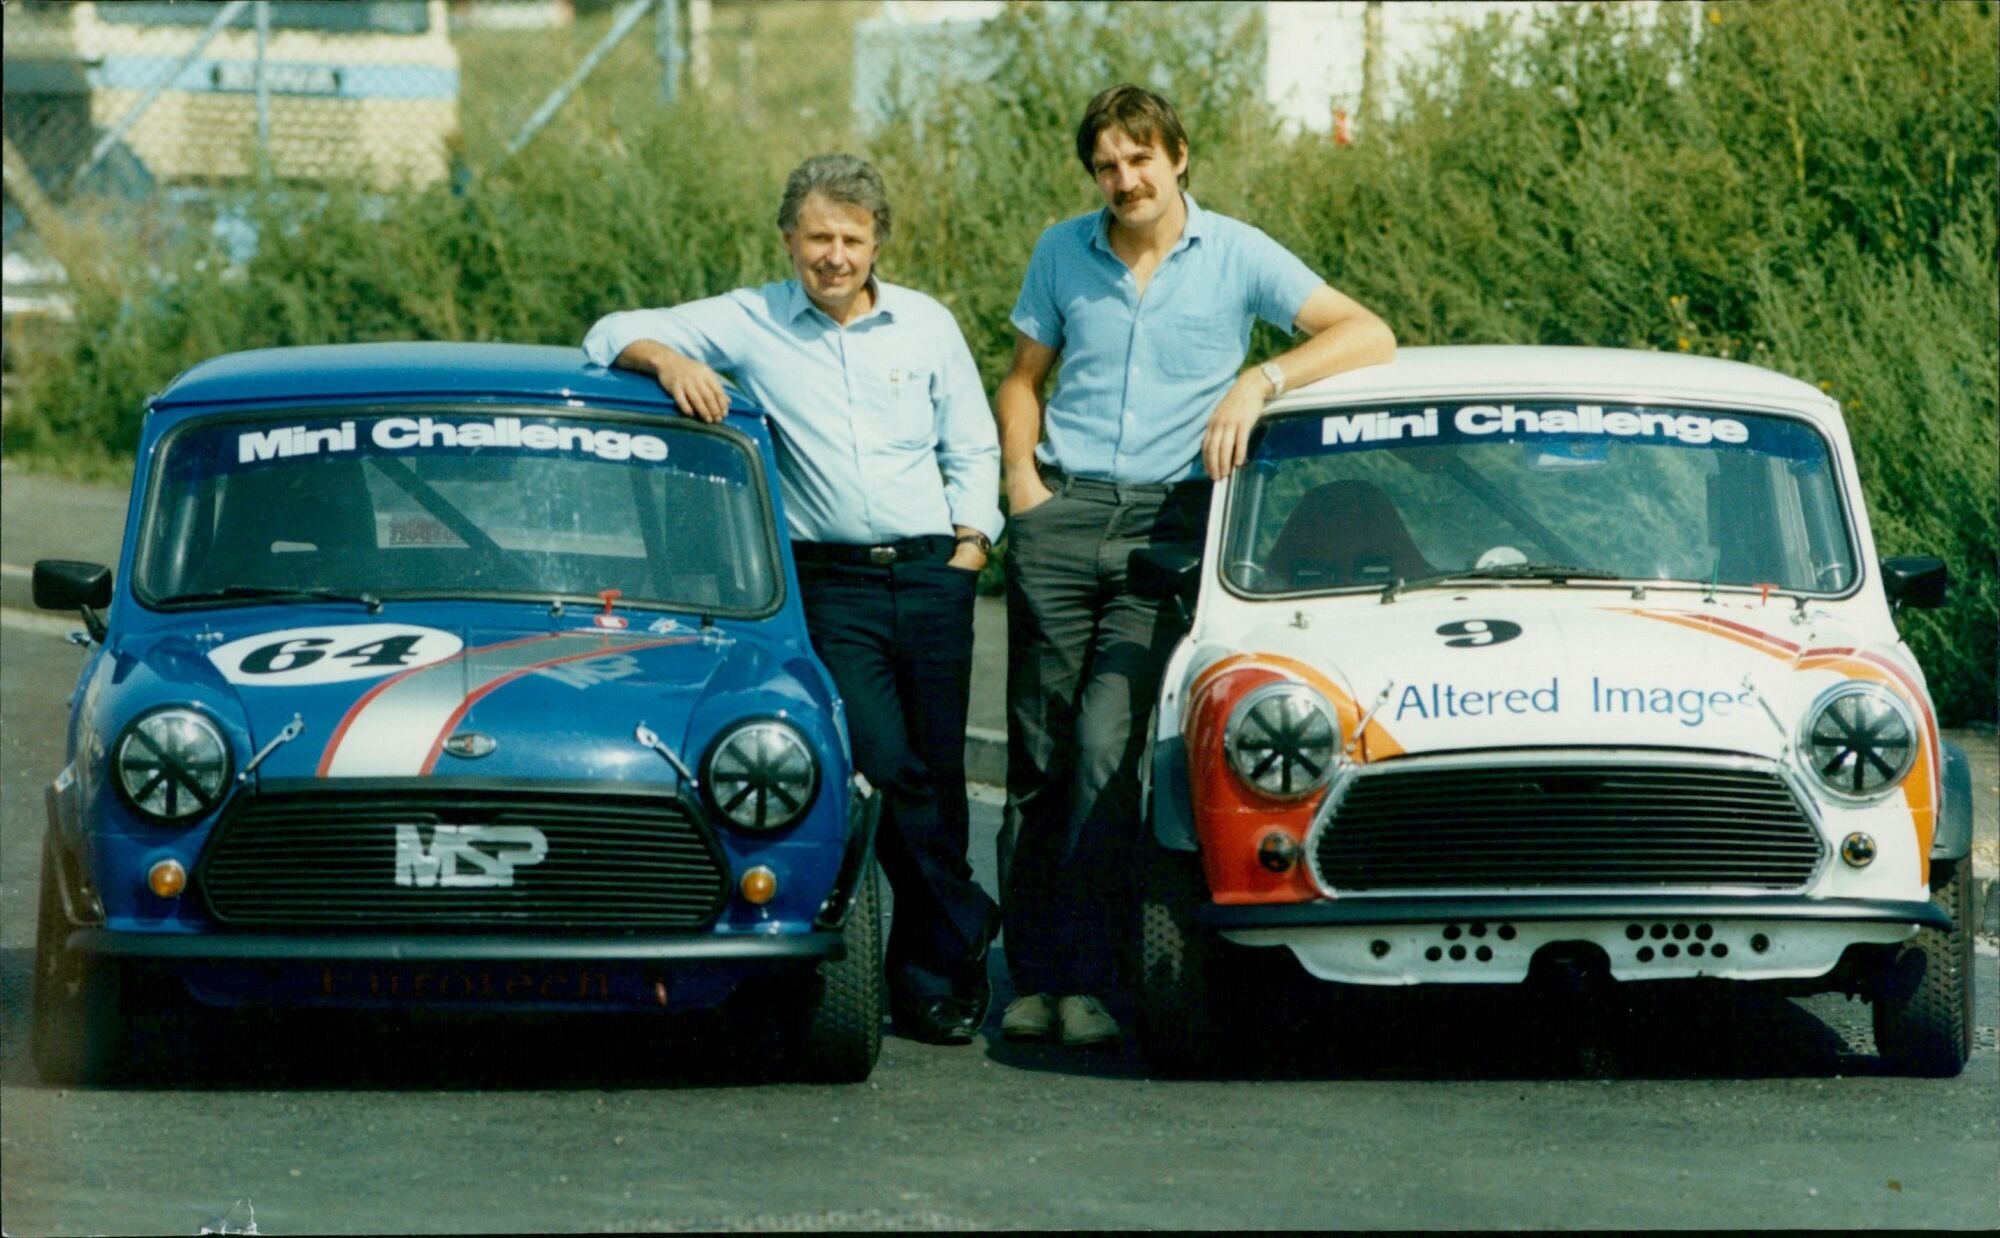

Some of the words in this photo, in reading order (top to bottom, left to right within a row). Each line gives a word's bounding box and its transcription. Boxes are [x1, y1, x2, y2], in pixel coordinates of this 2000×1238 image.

[237, 420, 357, 464] Mini
[371, 416, 669, 462] Challenge
[1320, 407, 1440, 447] Mini
[1453, 403, 1750, 446] Challenge
[238, 634, 420, 674] 64
[1435, 618, 1523, 648] 9
[1396, 677, 1560, 722] Altered
[394, 824, 549, 888] MSP
